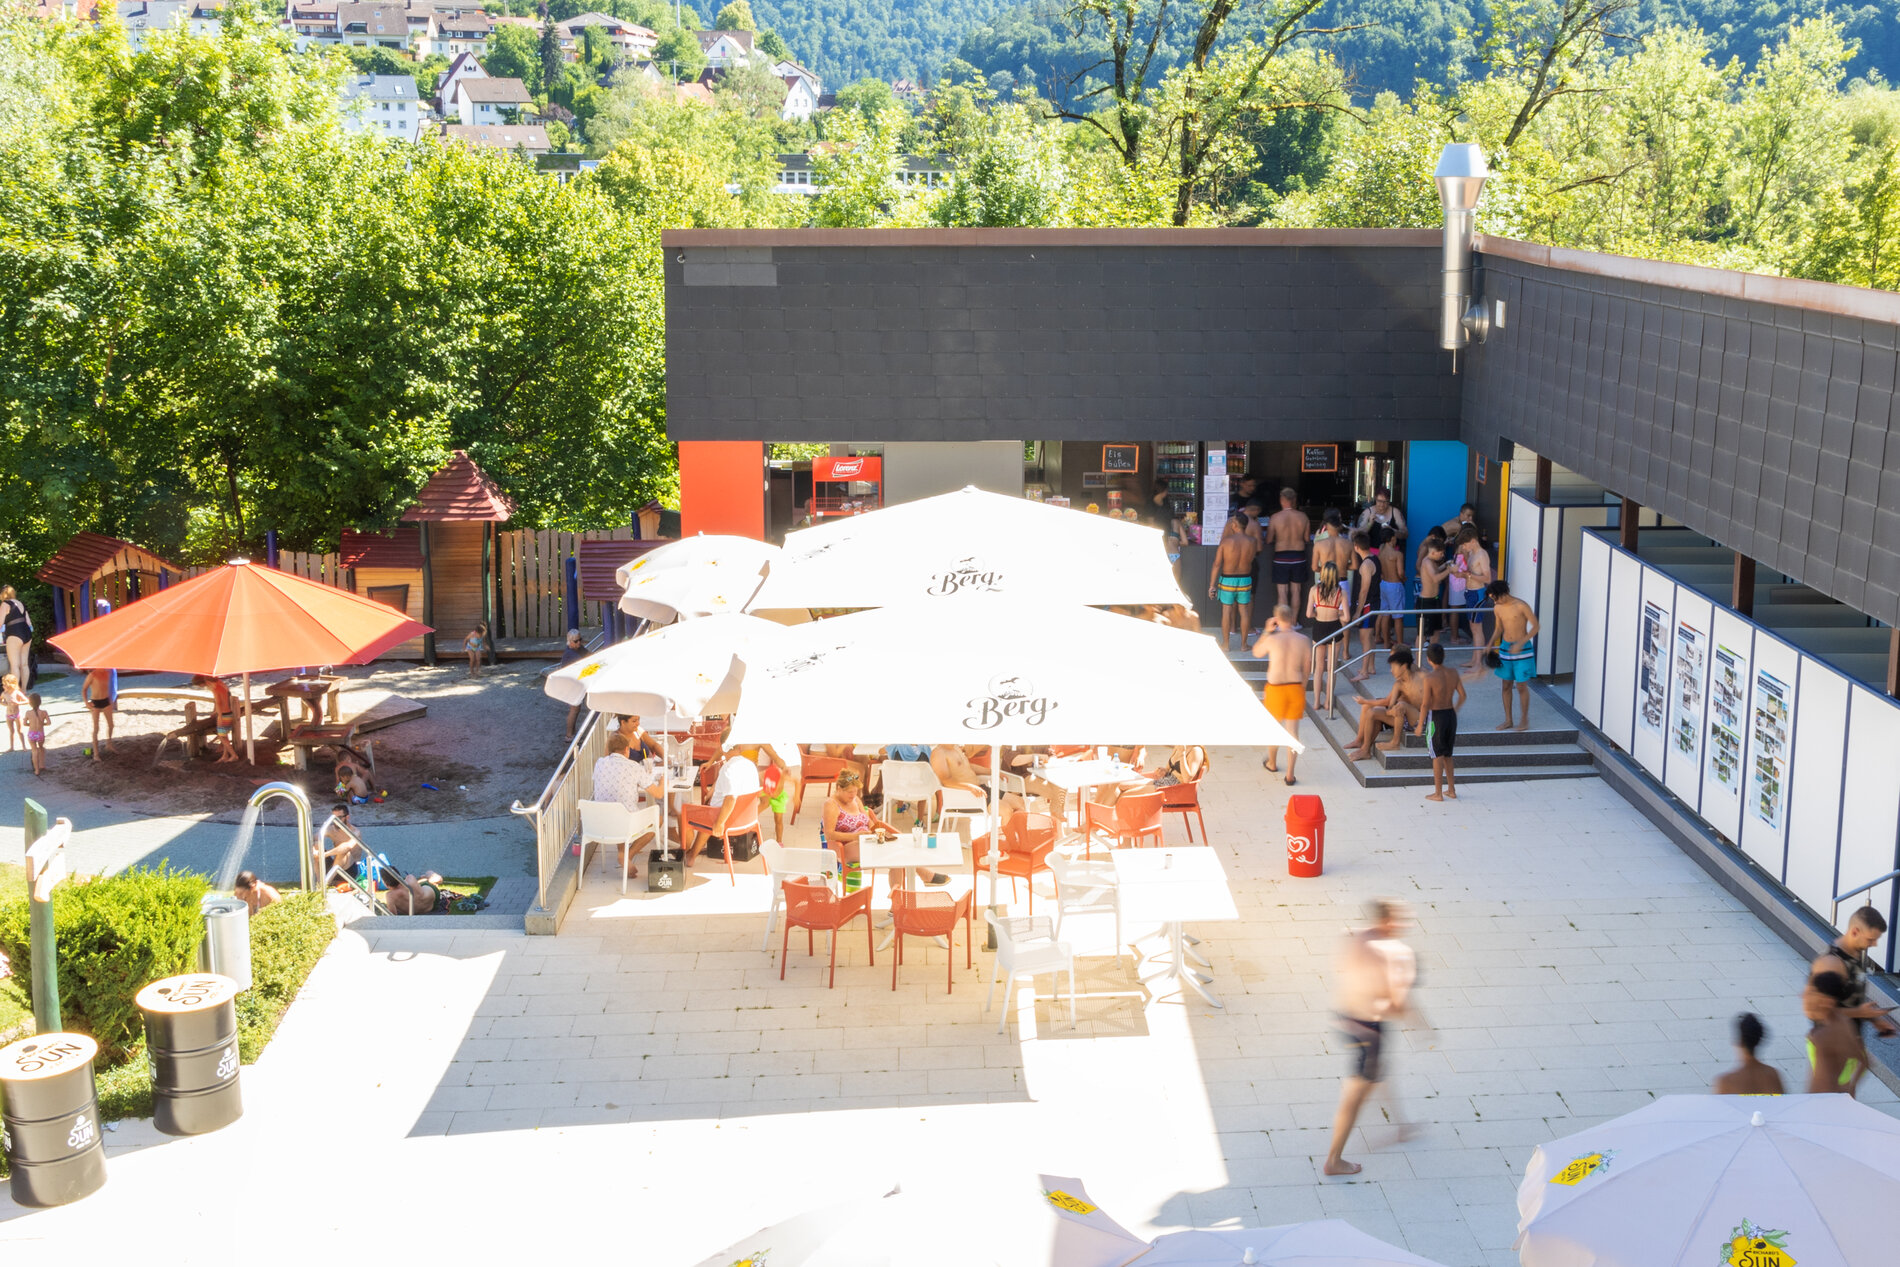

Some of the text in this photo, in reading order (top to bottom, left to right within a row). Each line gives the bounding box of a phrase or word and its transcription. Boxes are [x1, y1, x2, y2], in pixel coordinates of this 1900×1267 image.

[1109, 450, 1121, 458] Eis
[927, 571, 1004, 597] Berg
[962, 697, 1059, 730] Berg
[168, 981, 217, 1006] SUN
[16, 1043, 83, 1073] SUN
[216, 1056, 238, 1078] SUN
[67, 1124, 95, 1147] SUN
[1738, 1250, 1780, 1267] SUN
